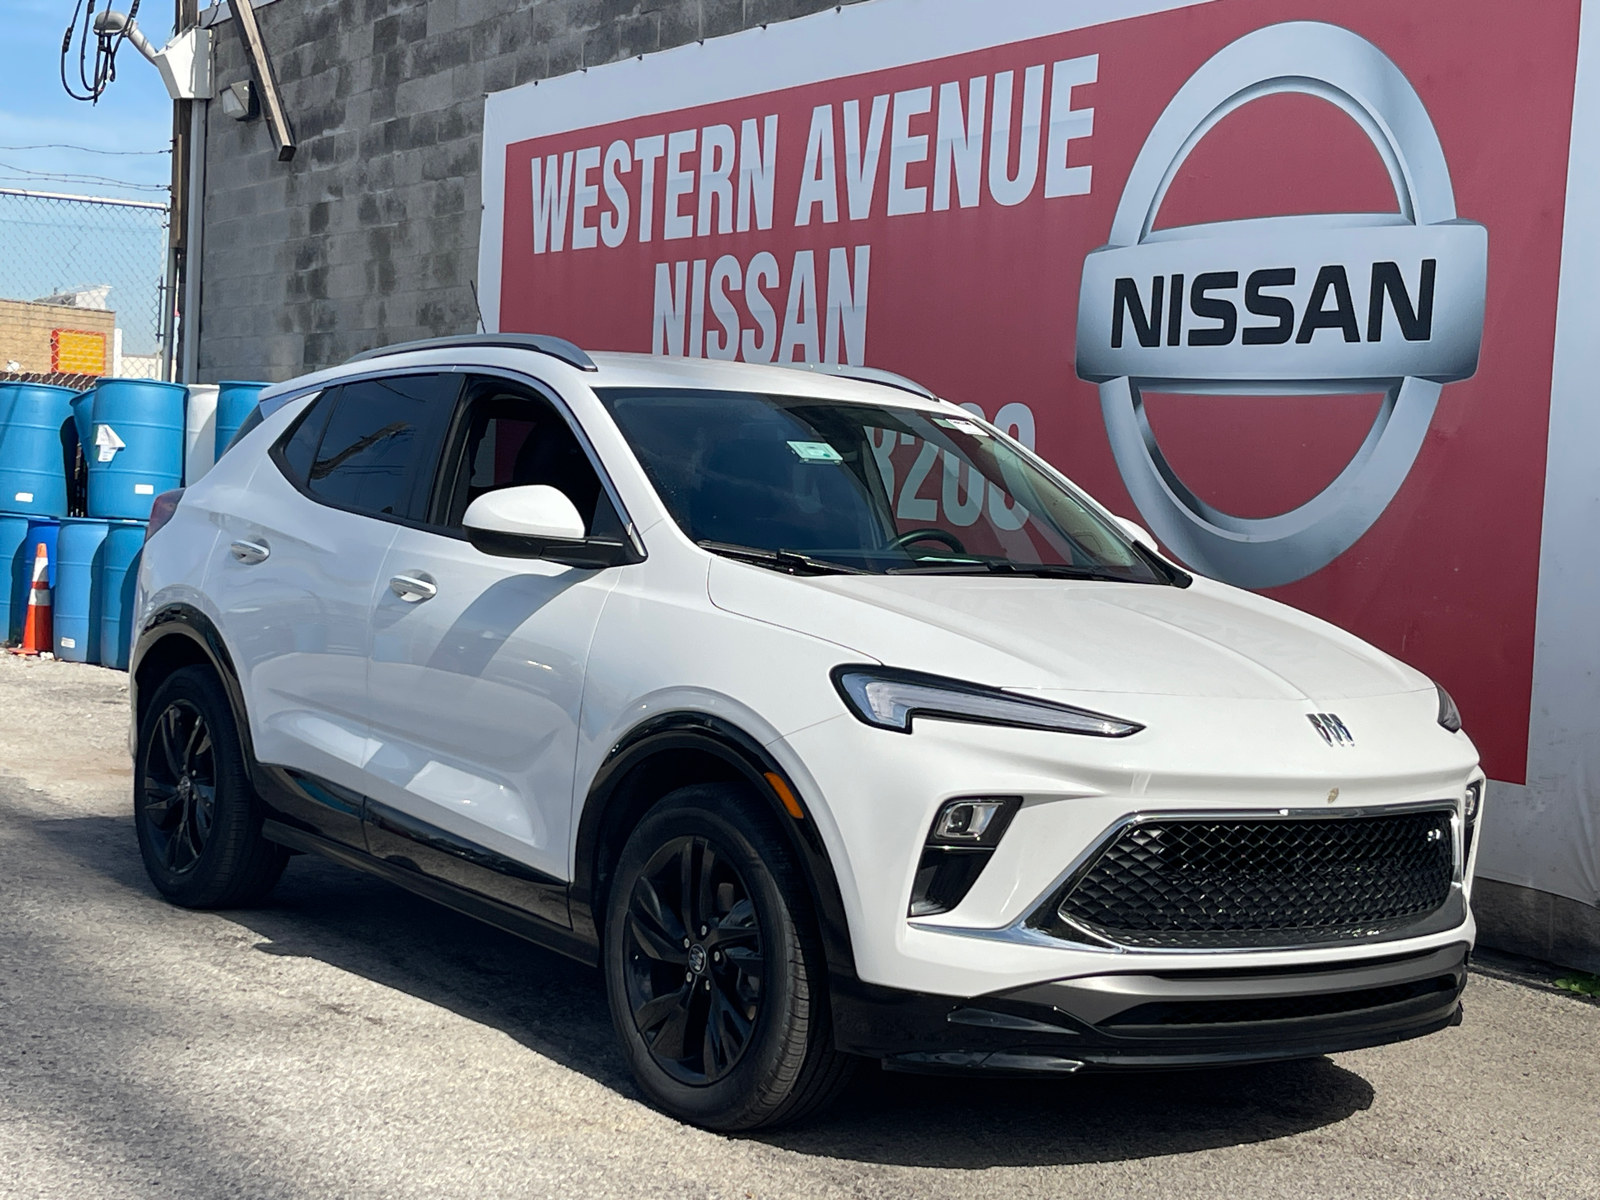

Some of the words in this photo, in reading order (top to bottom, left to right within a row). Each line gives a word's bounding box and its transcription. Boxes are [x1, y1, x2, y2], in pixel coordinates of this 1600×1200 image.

[530, 115, 779, 254] WESTERN
[795, 54, 1099, 226] AVENUE
[652, 245, 871, 366] NISSAN
[1111, 259, 1437, 348] NISSAN
